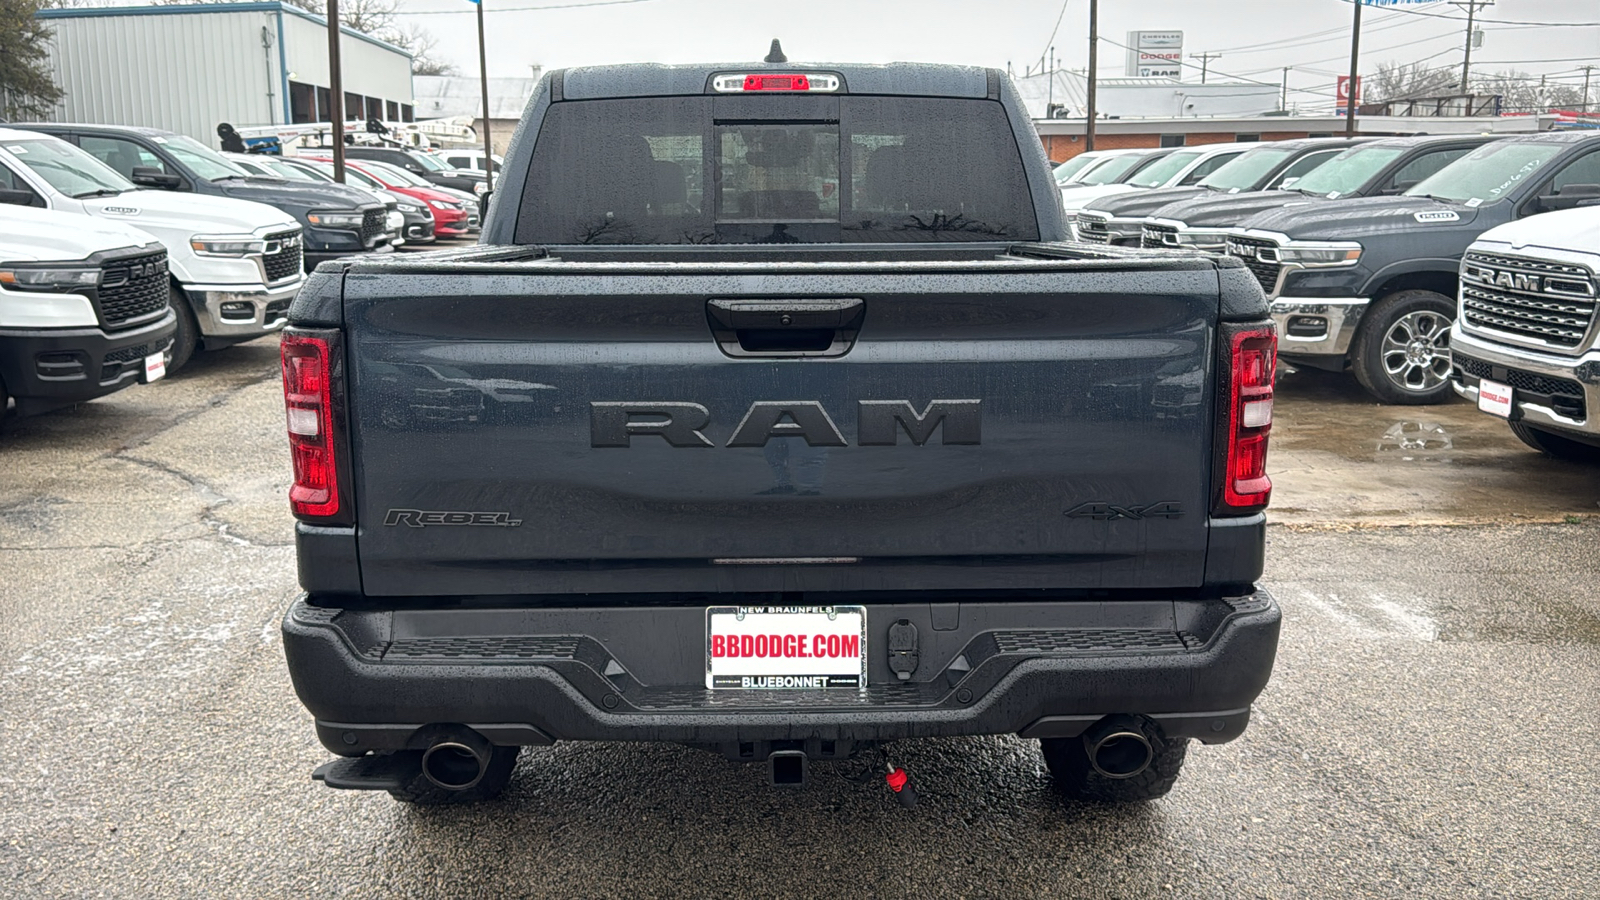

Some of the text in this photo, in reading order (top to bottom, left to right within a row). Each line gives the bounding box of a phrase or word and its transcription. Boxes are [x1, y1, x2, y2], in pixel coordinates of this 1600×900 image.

[1225, 240, 1256, 257] RAM
[1479, 267, 1540, 292] RAM
[590, 400, 981, 447] RAM
[383, 508, 523, 528] REBEL
[768, 606, 833, 614] BRAUNFELS
[712, 634, 859, 658] BBDODGE.COM
[742, 676, 829, 688] BLUEBONNET
